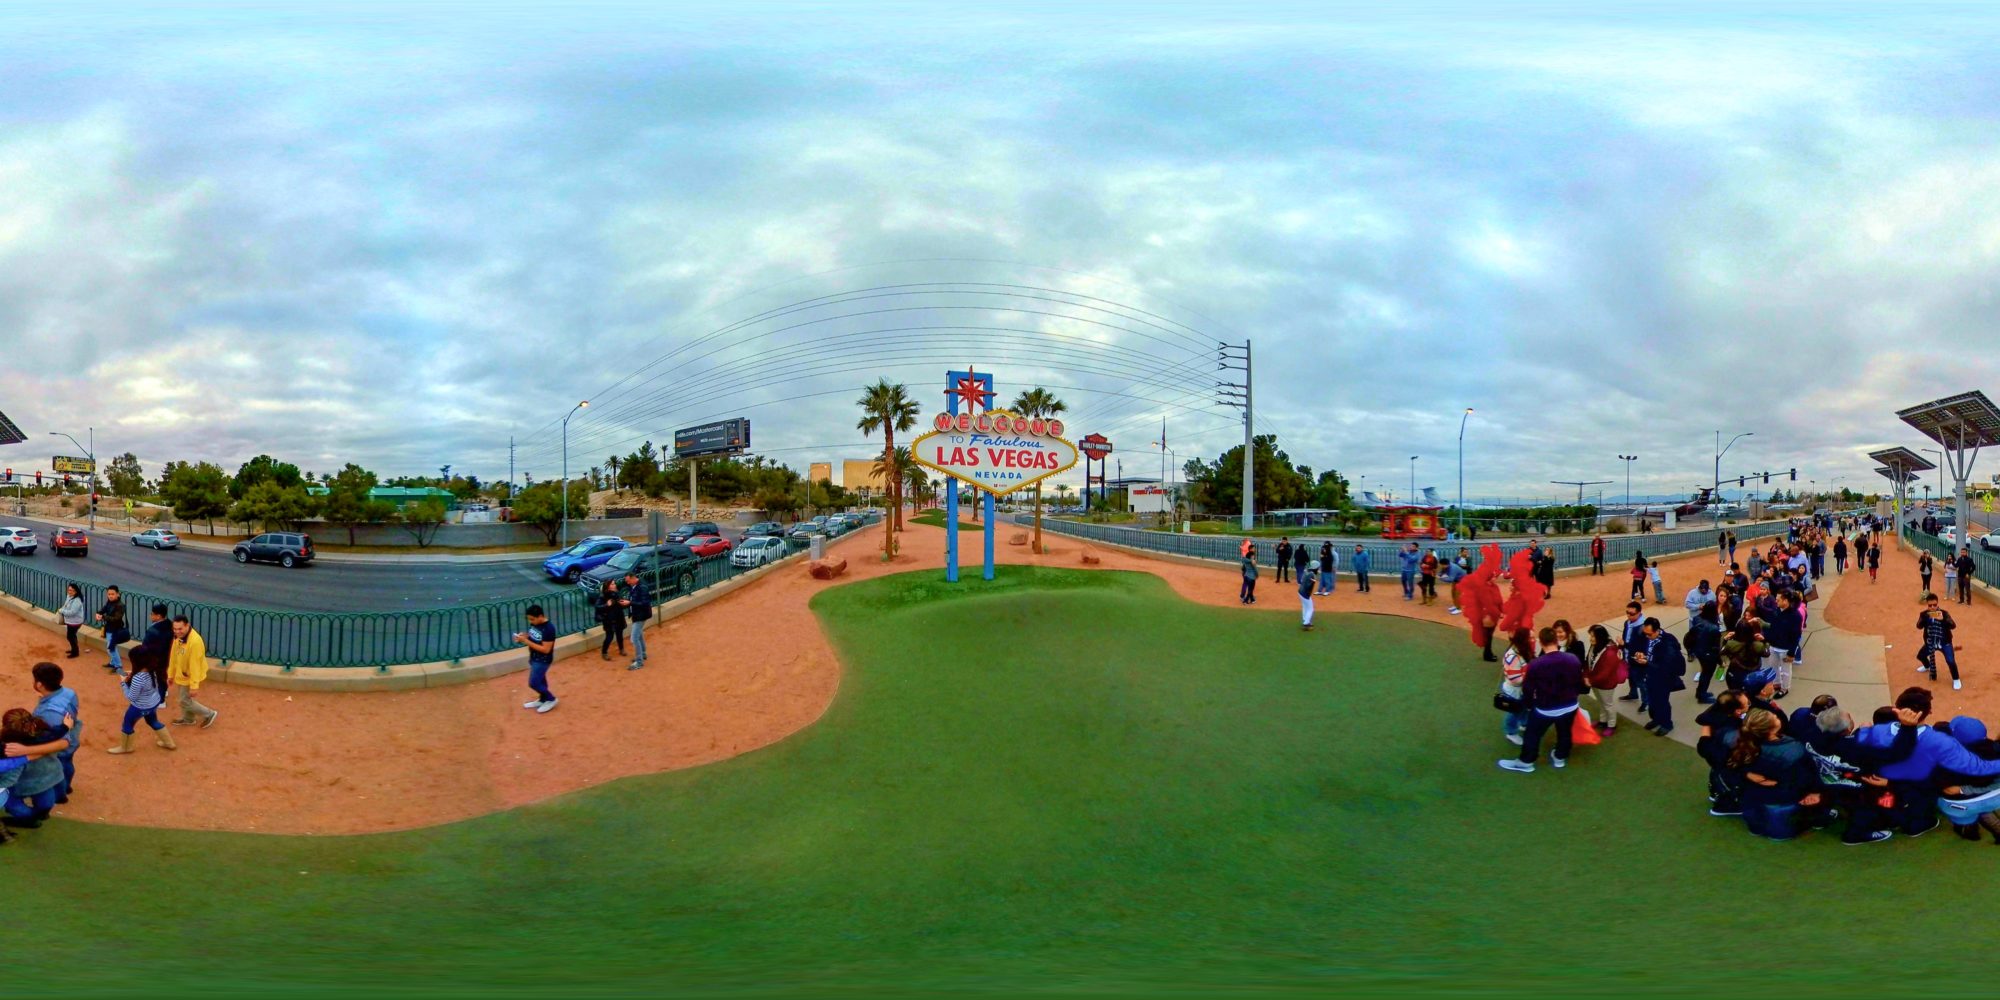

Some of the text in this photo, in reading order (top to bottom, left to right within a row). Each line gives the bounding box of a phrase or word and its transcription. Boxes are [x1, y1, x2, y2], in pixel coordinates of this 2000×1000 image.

[936, 414, 1061, 436] WELCOME
[949, 434, 1045, 448] TO Fabulous
[936, 446, 1058, 470] LAS VEGAS
[975, 471, 1022, 480] NEVADA
